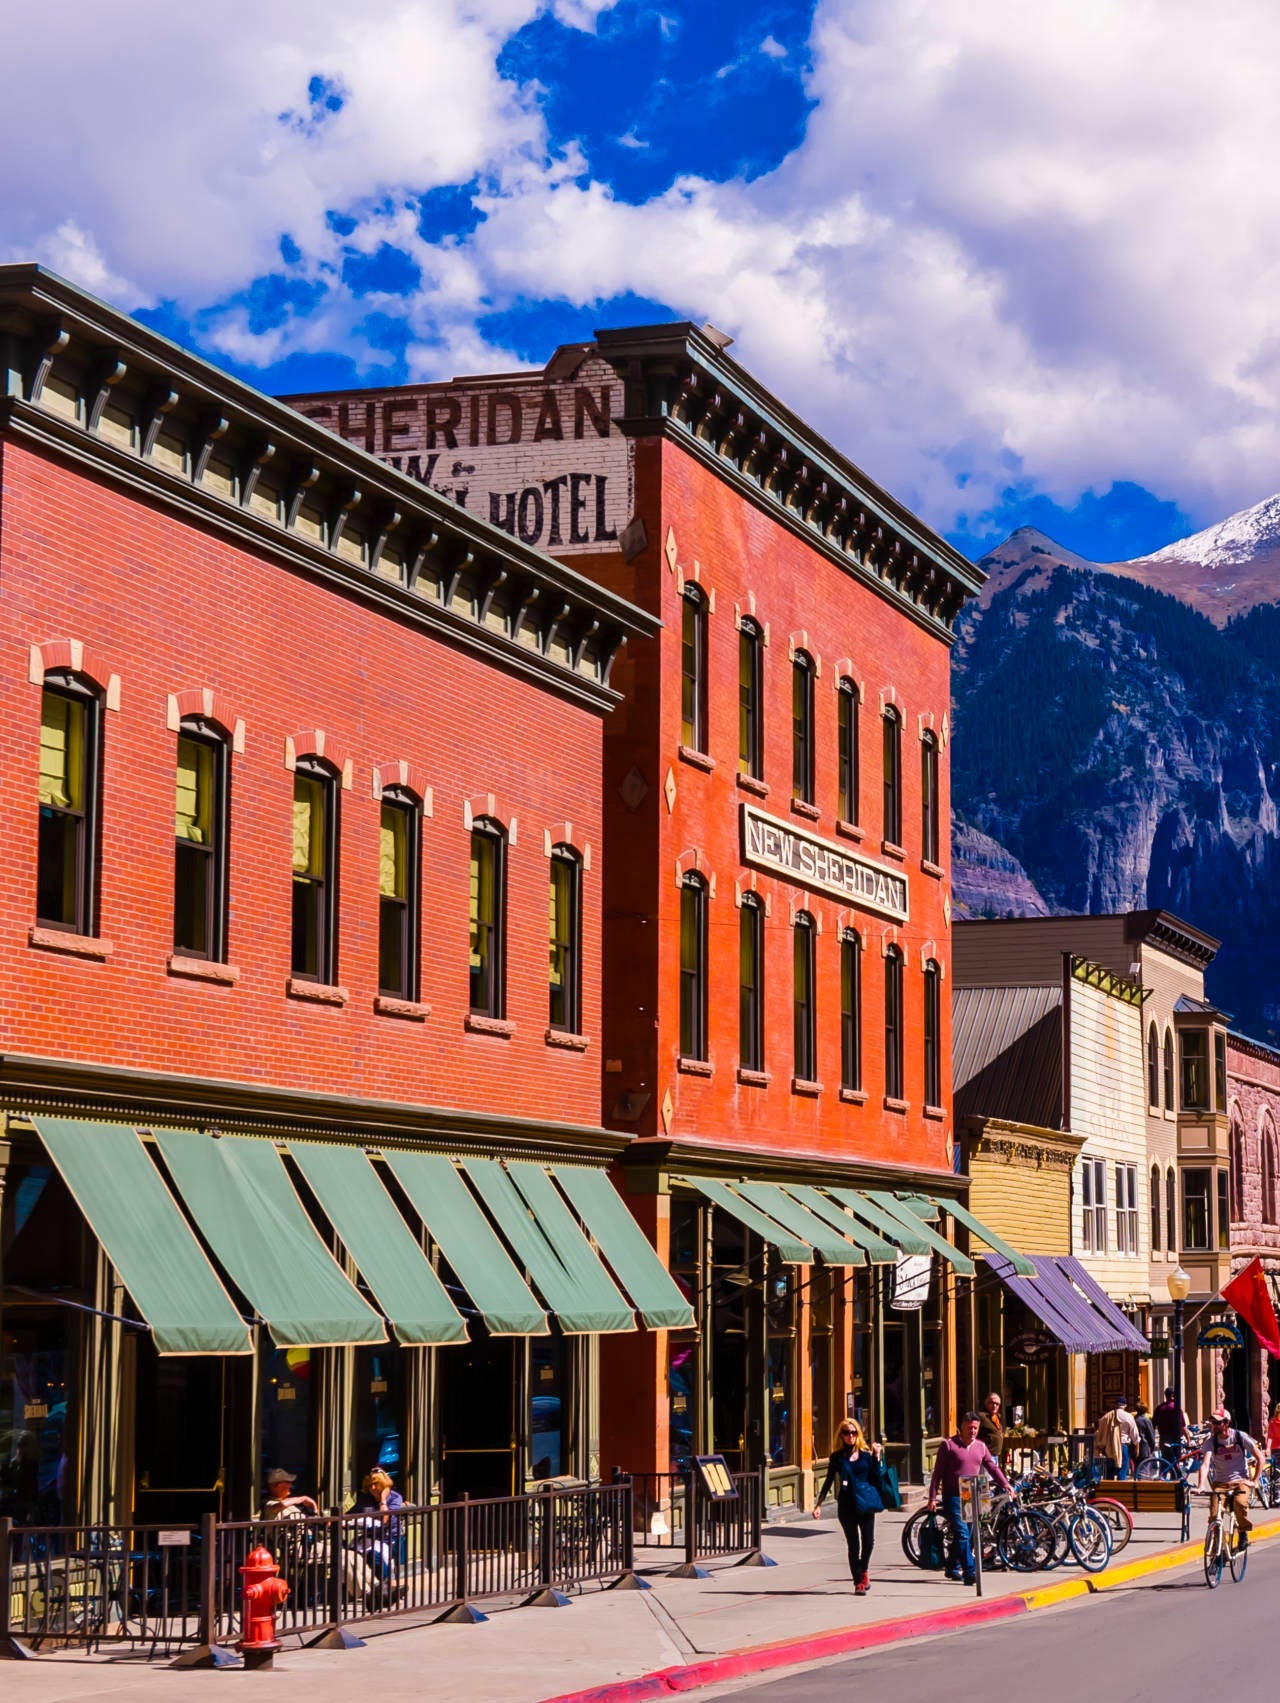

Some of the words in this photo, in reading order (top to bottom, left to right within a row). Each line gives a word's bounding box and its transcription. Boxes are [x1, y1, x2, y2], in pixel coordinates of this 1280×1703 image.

[488, 472, 617, 547] HOTEL
[747, 819, 794, 868] NEW
[799, 841, 900, 910] SHERIDAN
